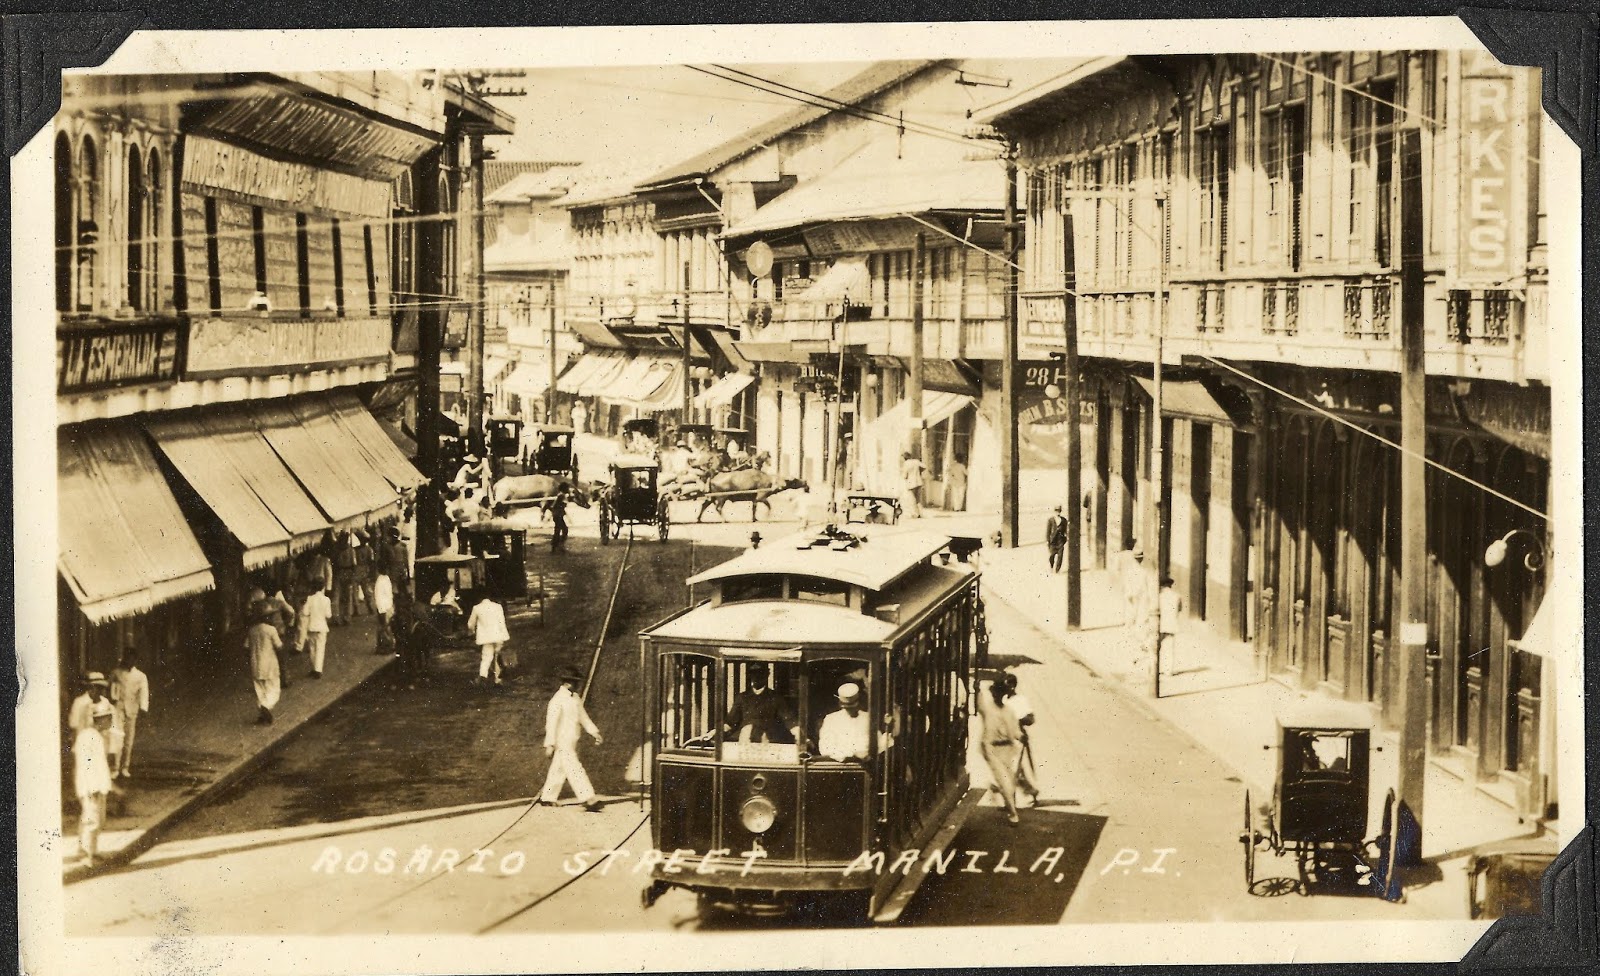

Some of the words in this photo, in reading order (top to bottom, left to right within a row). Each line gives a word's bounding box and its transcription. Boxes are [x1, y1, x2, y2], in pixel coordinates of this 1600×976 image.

[64, 339, 85, 386] LA
[86, 332, 158, 382] ESMERALDA
[1025, 367, 1049, 386] 28
